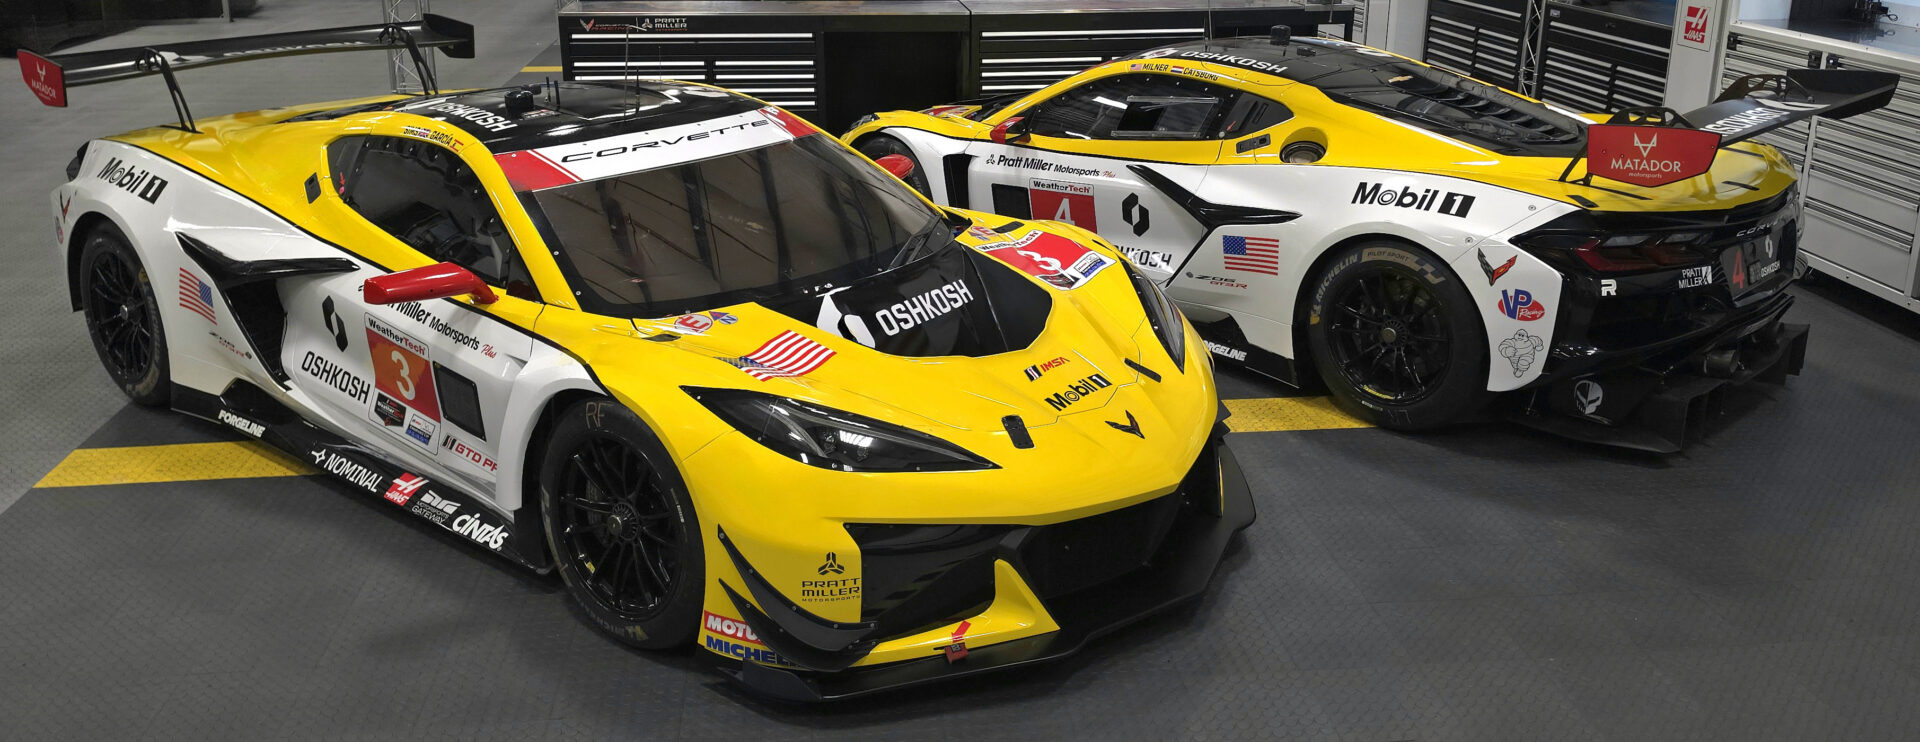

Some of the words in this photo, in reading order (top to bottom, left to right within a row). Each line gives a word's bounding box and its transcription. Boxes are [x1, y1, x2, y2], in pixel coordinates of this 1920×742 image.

[1142, 63, 1169, 72] MILNER
[1180, 51, 1288, 74] OSHKOSH
[561, 119, 770, 163] CORVETTE
[97, 157, 149, 193] Mobil
[997, 154, 1022, 168] Pratt
[1023, 157, 1053, 172] Miller
[1054, 164, 1099, 177] Motorsports
[1610, 157, 1681, 173] MATADOR
[1033, 181, 1091, 194] WeatherTech
[1351, 182, 1440, 211] Mobil
[1682, 268, 1701, 278] PRATT
[1732, 250, 1745, 288] 4
[1678, 277, 1702, 289] MILLER
[875, 279, 974, 337] OSHKOSH
[1502, 289, 1532, 320] VP
[368, 317, 426, 356] WeatherTech
[429, 317, 480, 351] Motorsports
[481, 343, 497, 359] Plus
[391, 350, 416, 400] 3
[1040, 356, 1070, 373] IMSA
[301, 351, 371, 404] OSHKOSH
[1044, 378, 1098, 412] Mobil
[218, 410, 266, 437] FORGELINE
[456, 443, 482, 464] GTD
[323, 453, 383, 493] NOMINAL
[411, 506, 446, 523] GATEWAY
[416, 501, 449, 518] MOTORSPORTS
[802, 578, 860, 588] PRATT
[802, 587, 860, 597] MILLER
